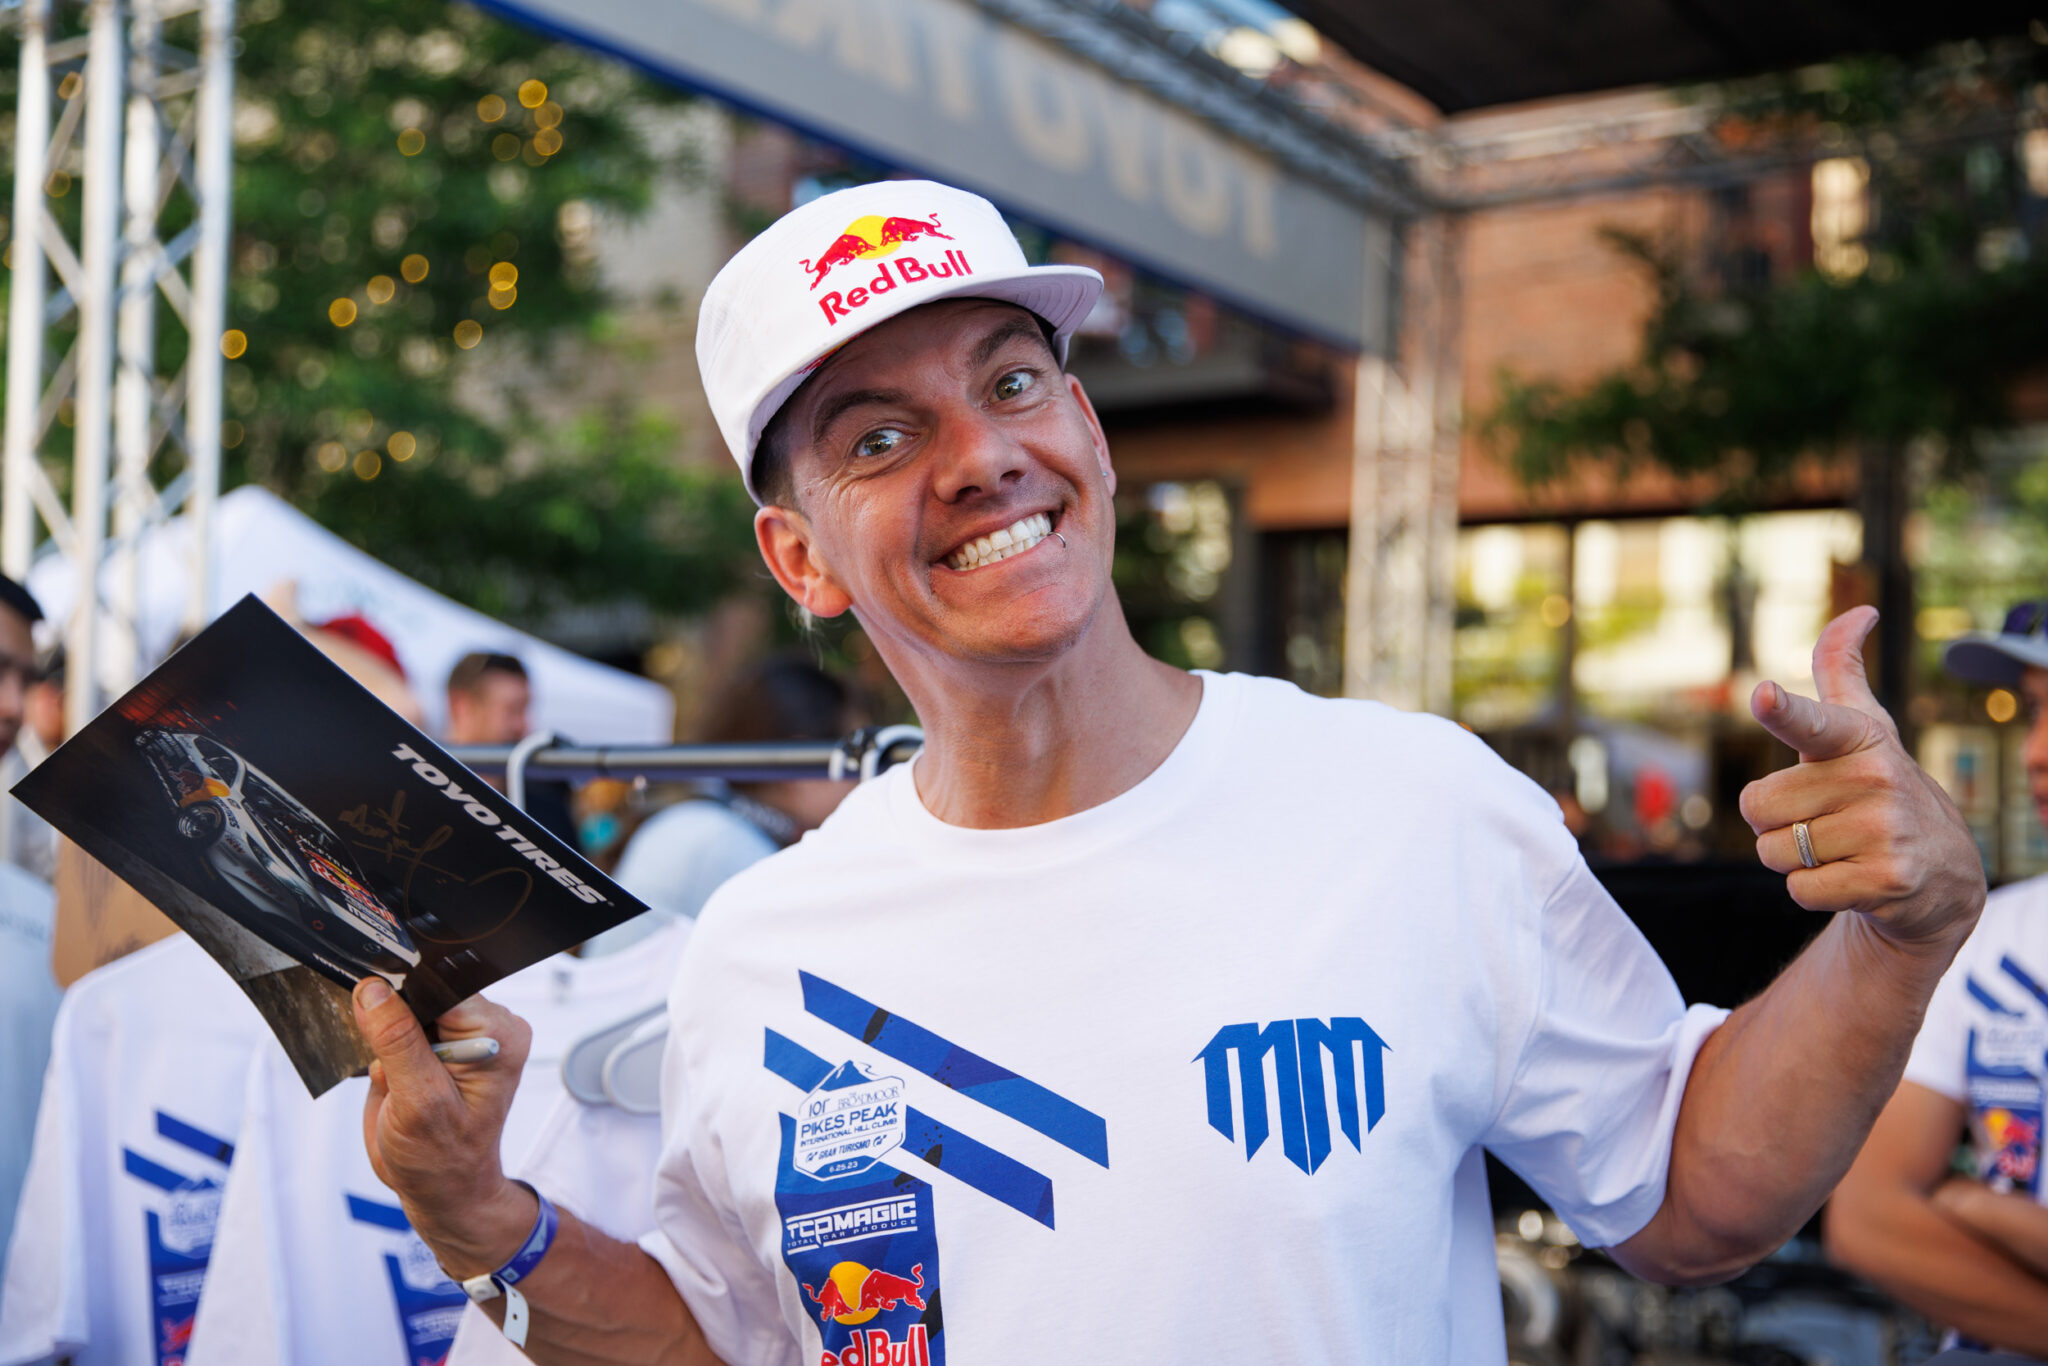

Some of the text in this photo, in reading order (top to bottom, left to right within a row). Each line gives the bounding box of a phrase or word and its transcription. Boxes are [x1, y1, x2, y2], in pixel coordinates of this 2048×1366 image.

[818, 250, 973, 326] Red Bull
[391, 743, 502, 826] TOYO
[495, 824, 607, 904] TIRES
[800, 1129, 852, 1147] INTERNATIONAL
[854, 1123, 870, 1133] HILL
[801, 1101, 898, 1138] PIKES PEAK
[787, 1219, 917, 1248] TOTAL CAR PRODUCE
[821, 1324, 931, 1366] ed Bull
